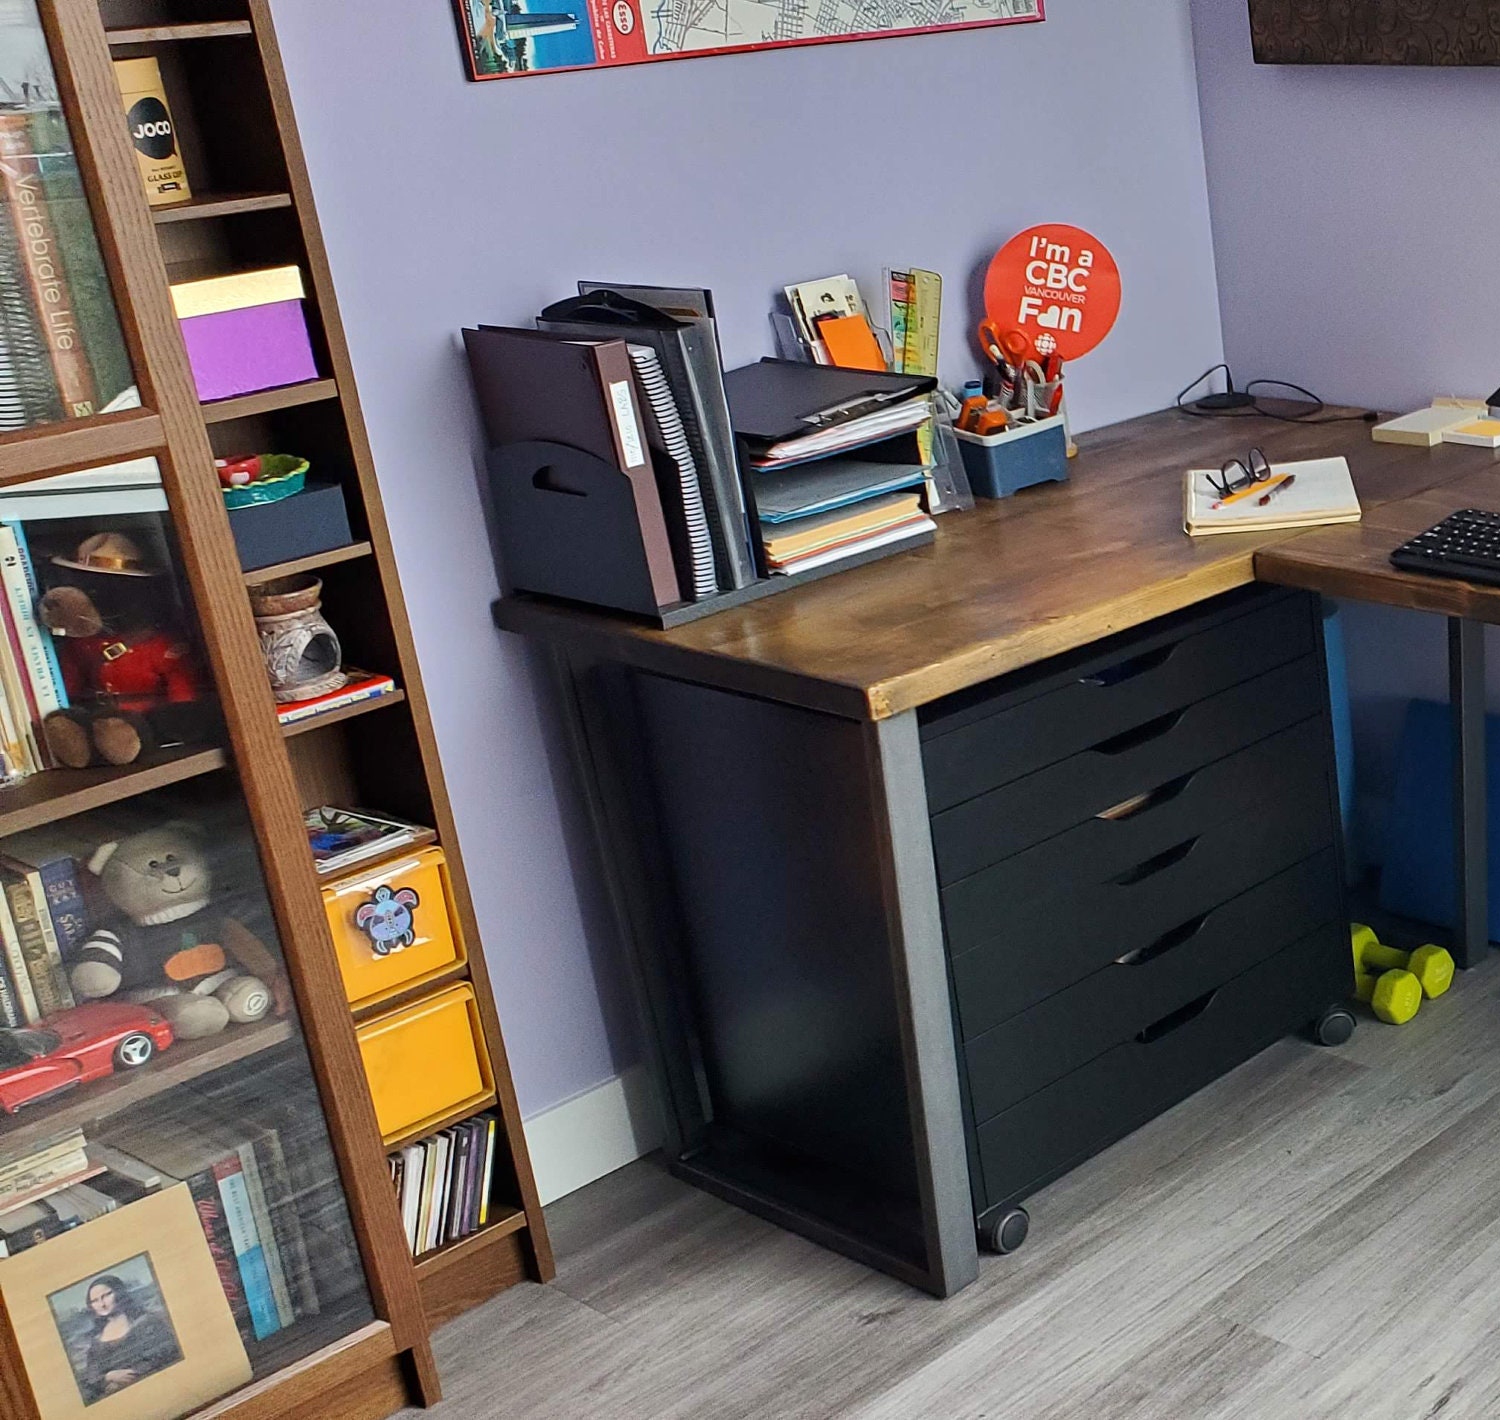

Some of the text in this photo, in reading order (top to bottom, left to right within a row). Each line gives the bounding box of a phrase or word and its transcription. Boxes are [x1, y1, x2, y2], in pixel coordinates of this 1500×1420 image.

[133, 120, 171, 139] JOCO
[147, 172, 172, 183] GLASS
[16, 173, 61, 304] Vertebrate
[50, 310, 76, 350] Life
[1078, 249, 1094, 268] a
[1025, 260, 1091, 293] CBC
[1023, 285, 1086, 304] VANCOUVER
